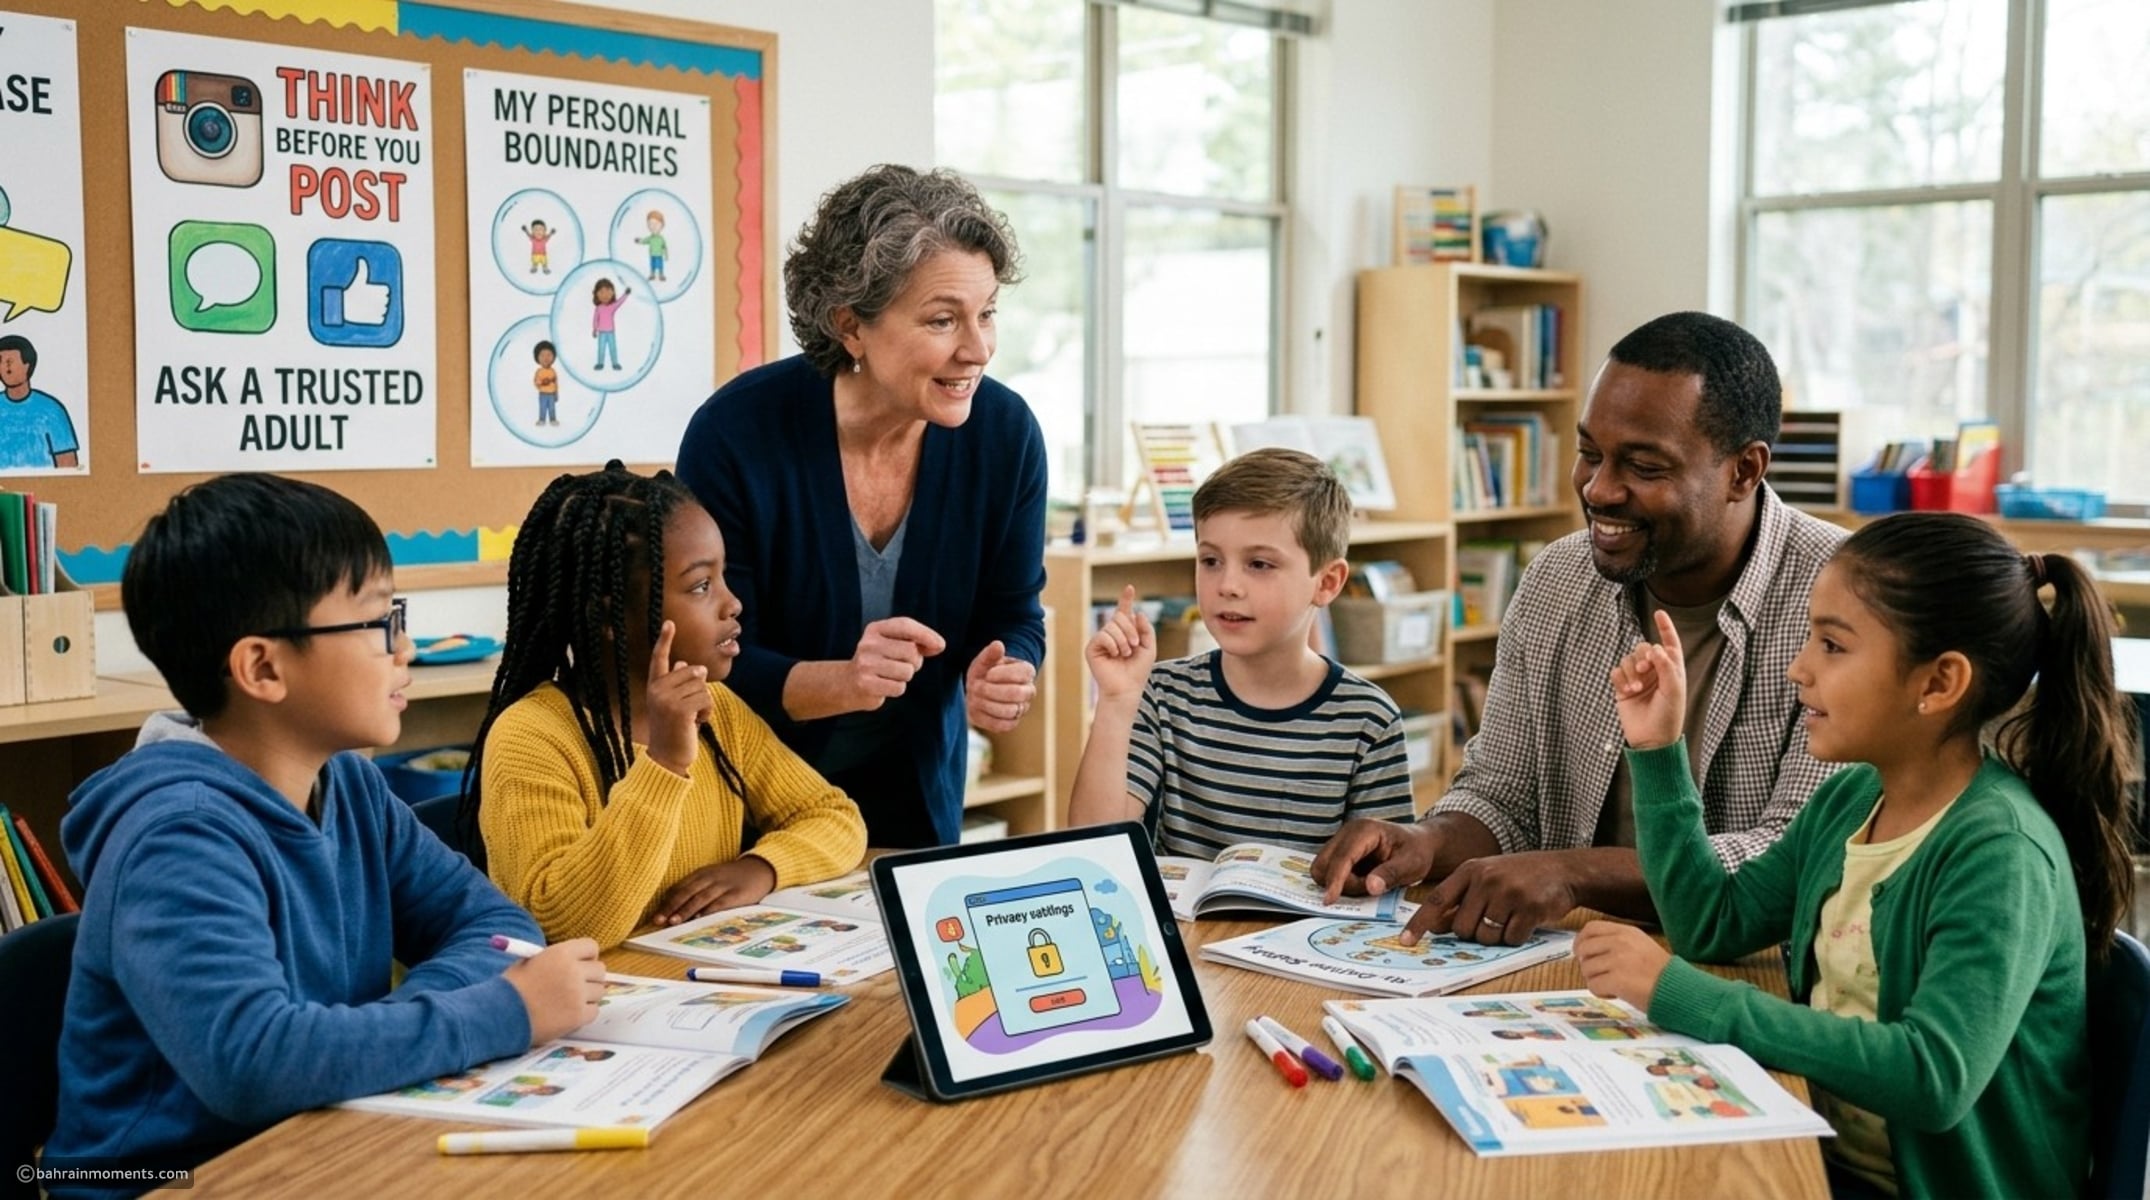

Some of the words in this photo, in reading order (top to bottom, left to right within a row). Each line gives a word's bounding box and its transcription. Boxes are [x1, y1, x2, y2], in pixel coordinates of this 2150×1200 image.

[276, 66, 419, 131] THINK
[494, 88, 537, 123] MY
[548, 94, 686, 140] PERSONAL
[276, 127, 367, 160] BEFORE
[374, 137, 420, 165] YOU
[505, 131, 678, 177] BOUNDARIES
[290, 164, 407, 222] POST
[154, 365, 228, 405] ASK
[239, 367, 264, 405] A
[274, 368, 424, 405] TRUSTED
[239, 414, 349, 451] ADULT
